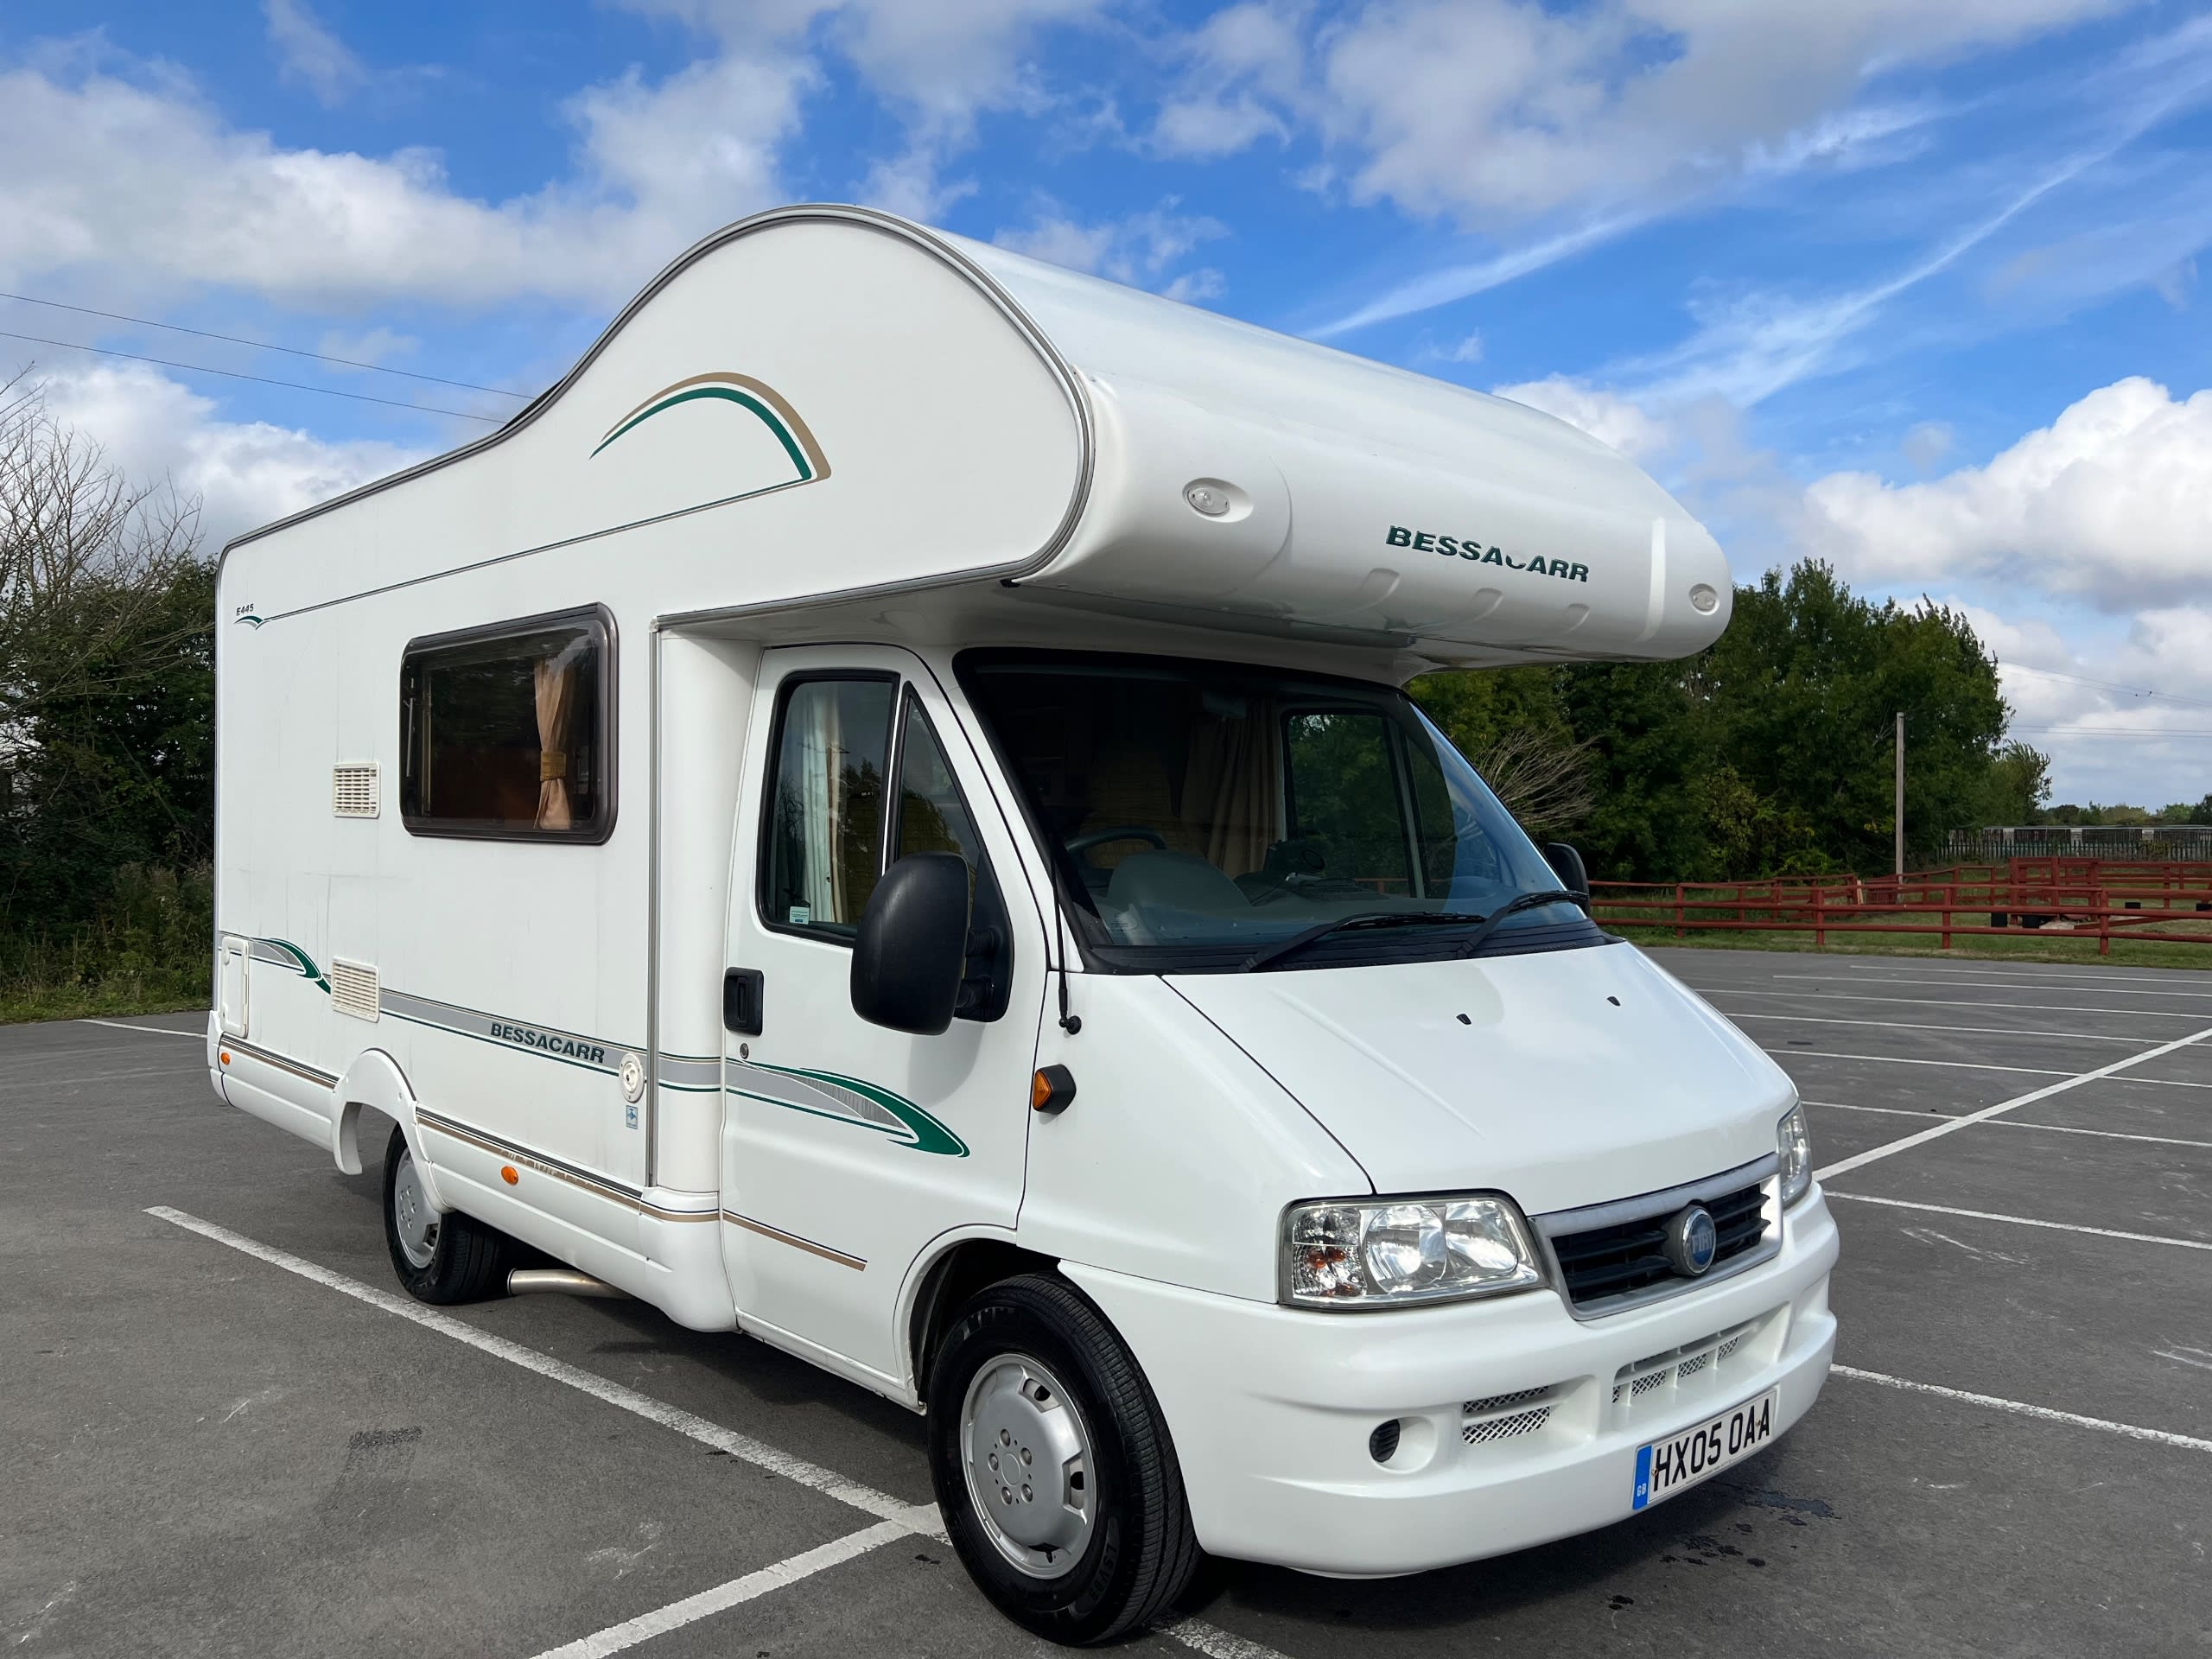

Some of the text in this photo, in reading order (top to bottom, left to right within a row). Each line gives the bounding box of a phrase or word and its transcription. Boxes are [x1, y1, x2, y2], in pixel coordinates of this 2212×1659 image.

[490, 1022, 605, 1064] BESSACARR
[1692, 1230, 1713, 1255] FIAT
[1653, 1421, 1722, 1491] HX05
[1637, 1483, 1646, 1497] GB
